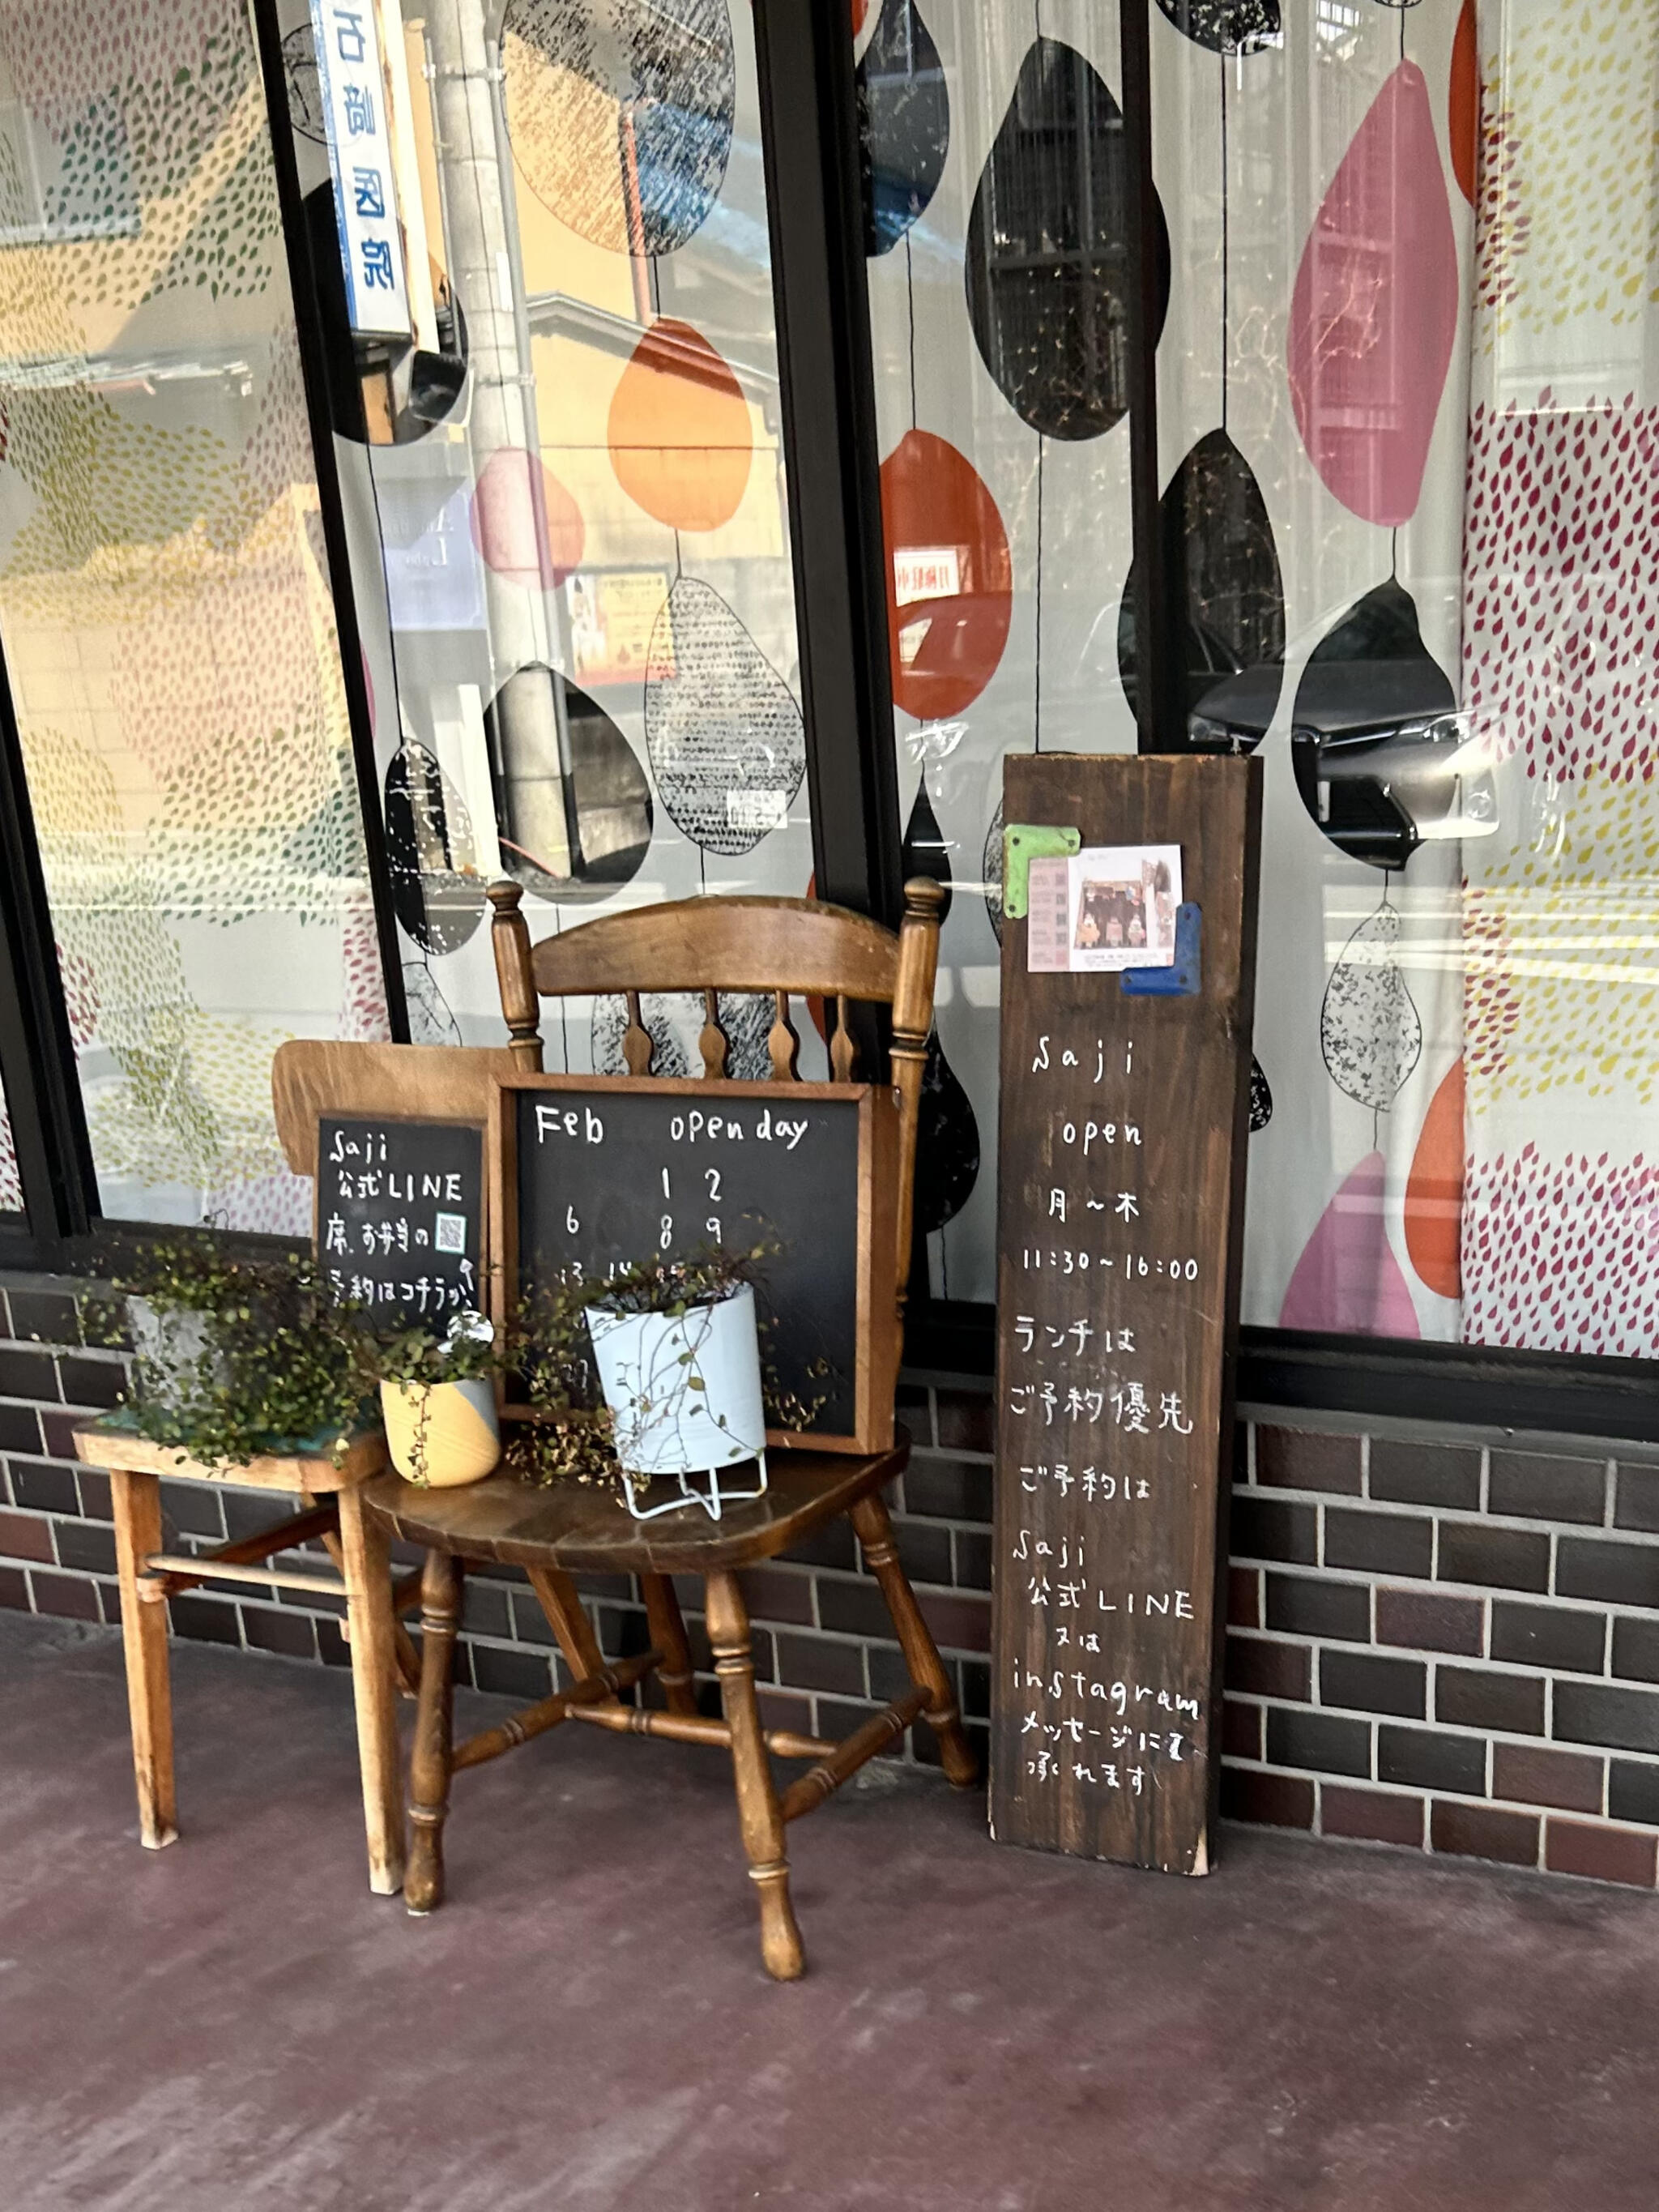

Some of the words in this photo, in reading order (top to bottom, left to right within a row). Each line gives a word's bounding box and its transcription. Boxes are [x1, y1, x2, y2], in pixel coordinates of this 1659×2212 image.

[1031, 1036, 1133, 1083] Saji
[329, 1130, 386, 1164] Saji
[535, 1105, 603, 1144] Feb
[671, 1110, 744, 1142] open
[756, 1108, 808, 1151] day
[1063, 1121, 1142, 1155] open
[662, 1168, 670, 1199] 1
[704, 1168, 722, 1202] 2
[566, 1205, 579, 1234] 6
[659, 1215, 672, 1249] 8
[706, 1217, 722, 1244] 9
[561, 1262, 583, 1287] 13
[1014, 1315, 1136, 1354] ランチは
[1010, 1381, 1193, 1435] ご予約優先
[1020, 1464, 1149, 1502] ご予約は
[1013, 1529, 1085, 1569] Saji
[1056, 1626, 1101, 1653] 又は
[1013, 1658, 1198, 1720] instagram
[1021, 1710, 1184, 1761] メッセージにて
